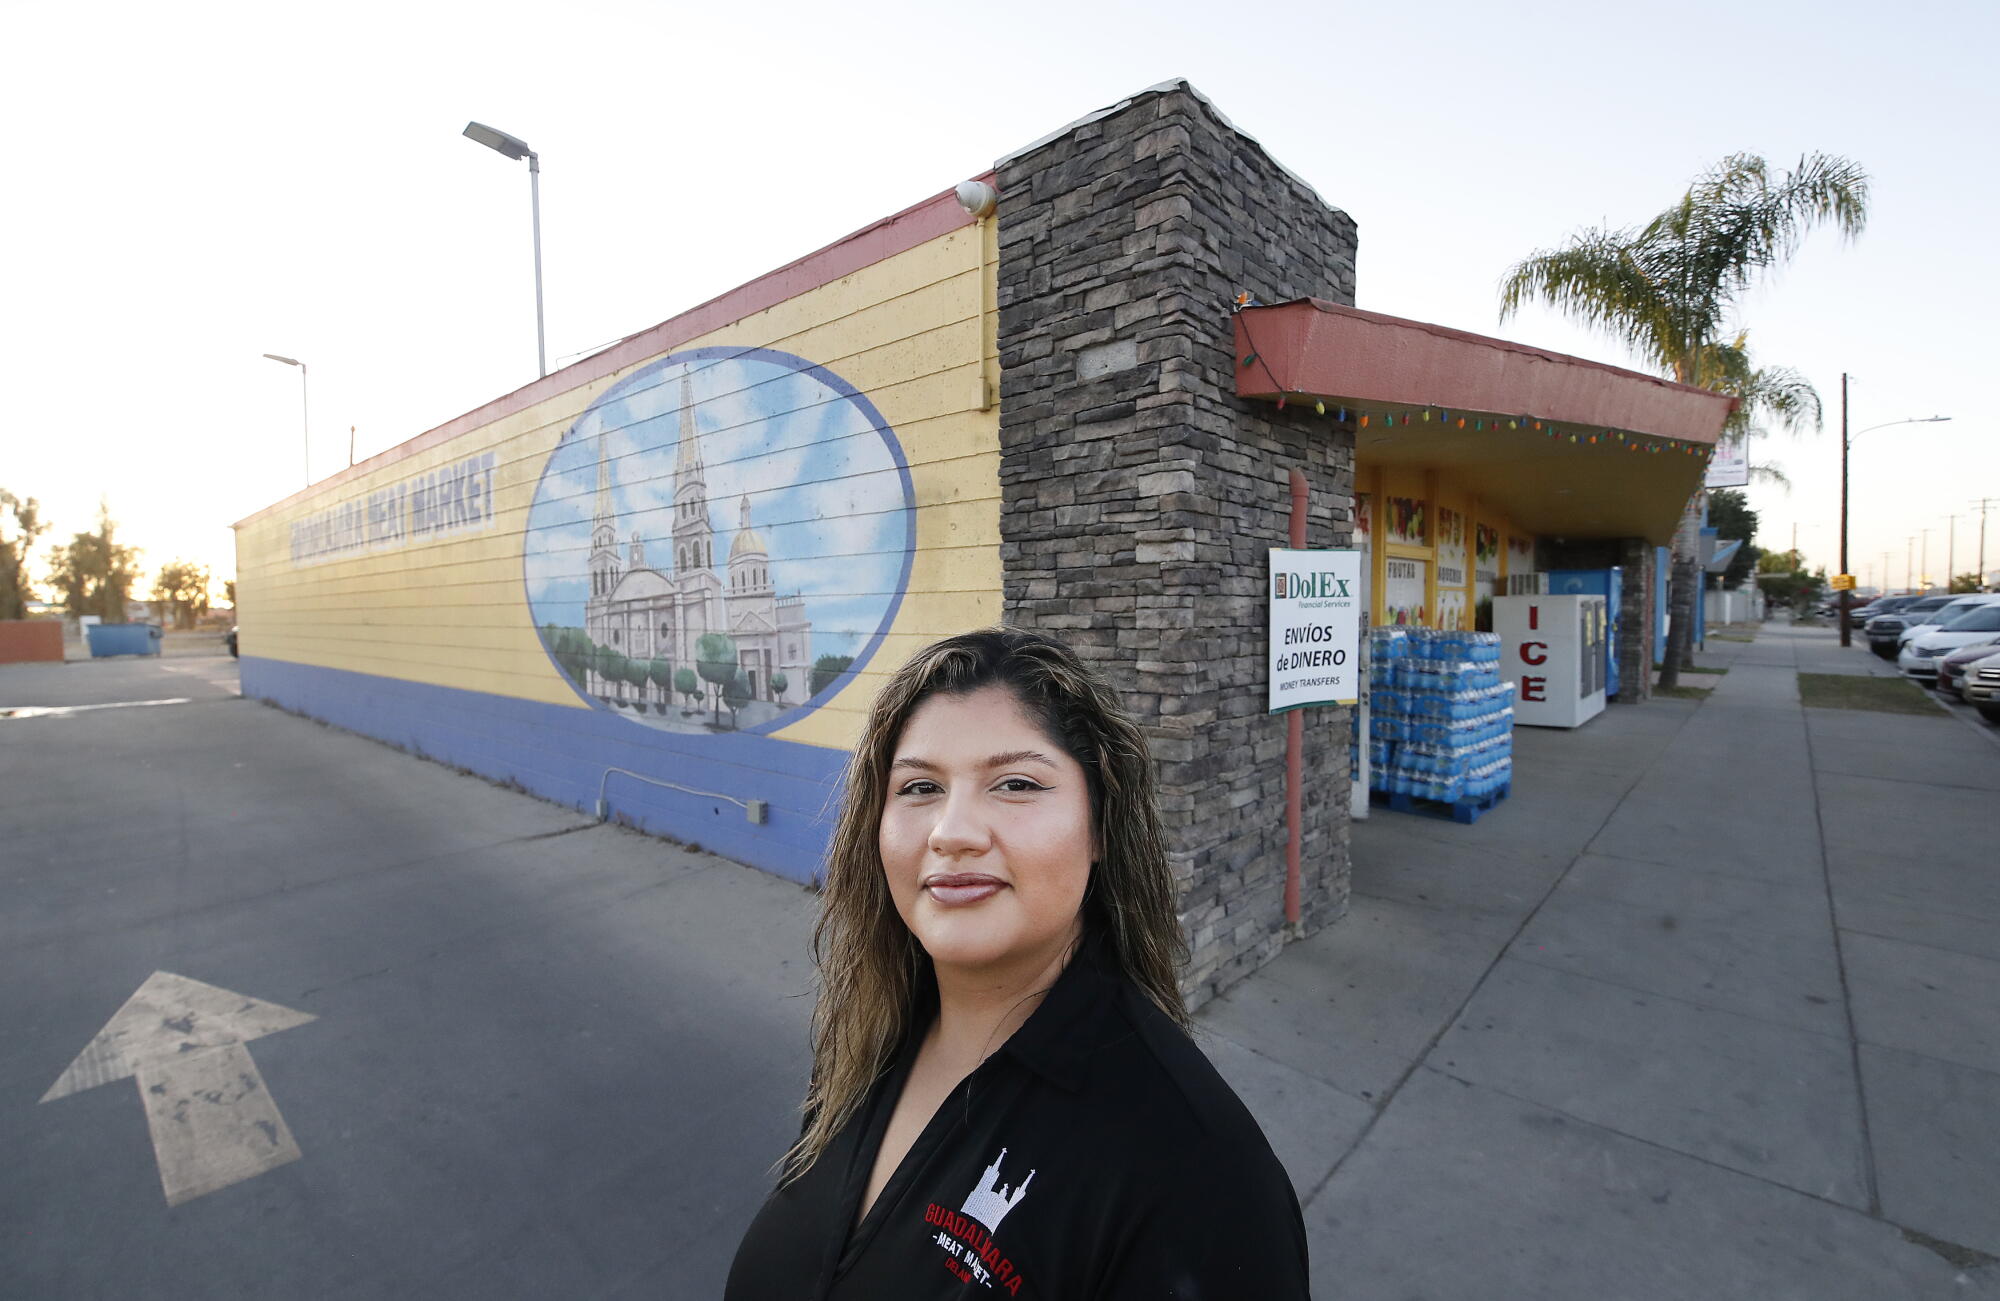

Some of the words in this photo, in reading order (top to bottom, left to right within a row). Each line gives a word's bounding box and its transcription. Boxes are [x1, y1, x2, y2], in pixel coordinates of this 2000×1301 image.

[412, 451, 496, 541] MARKET
[1289, 572, 1352, 599] DolEx
[1323, 600, 1351, 608] Services
[1284, 622, 1333, 645] ENVÍOS
[1276, 654, 1289, 672] de
[1291, 649, 1346, 670] DINERO
[1519, 606, 1548, 702] ICE
[1280, 680, 1299, 691] MONEY
[1300, 676, 1341, 688] TRANSFERS
